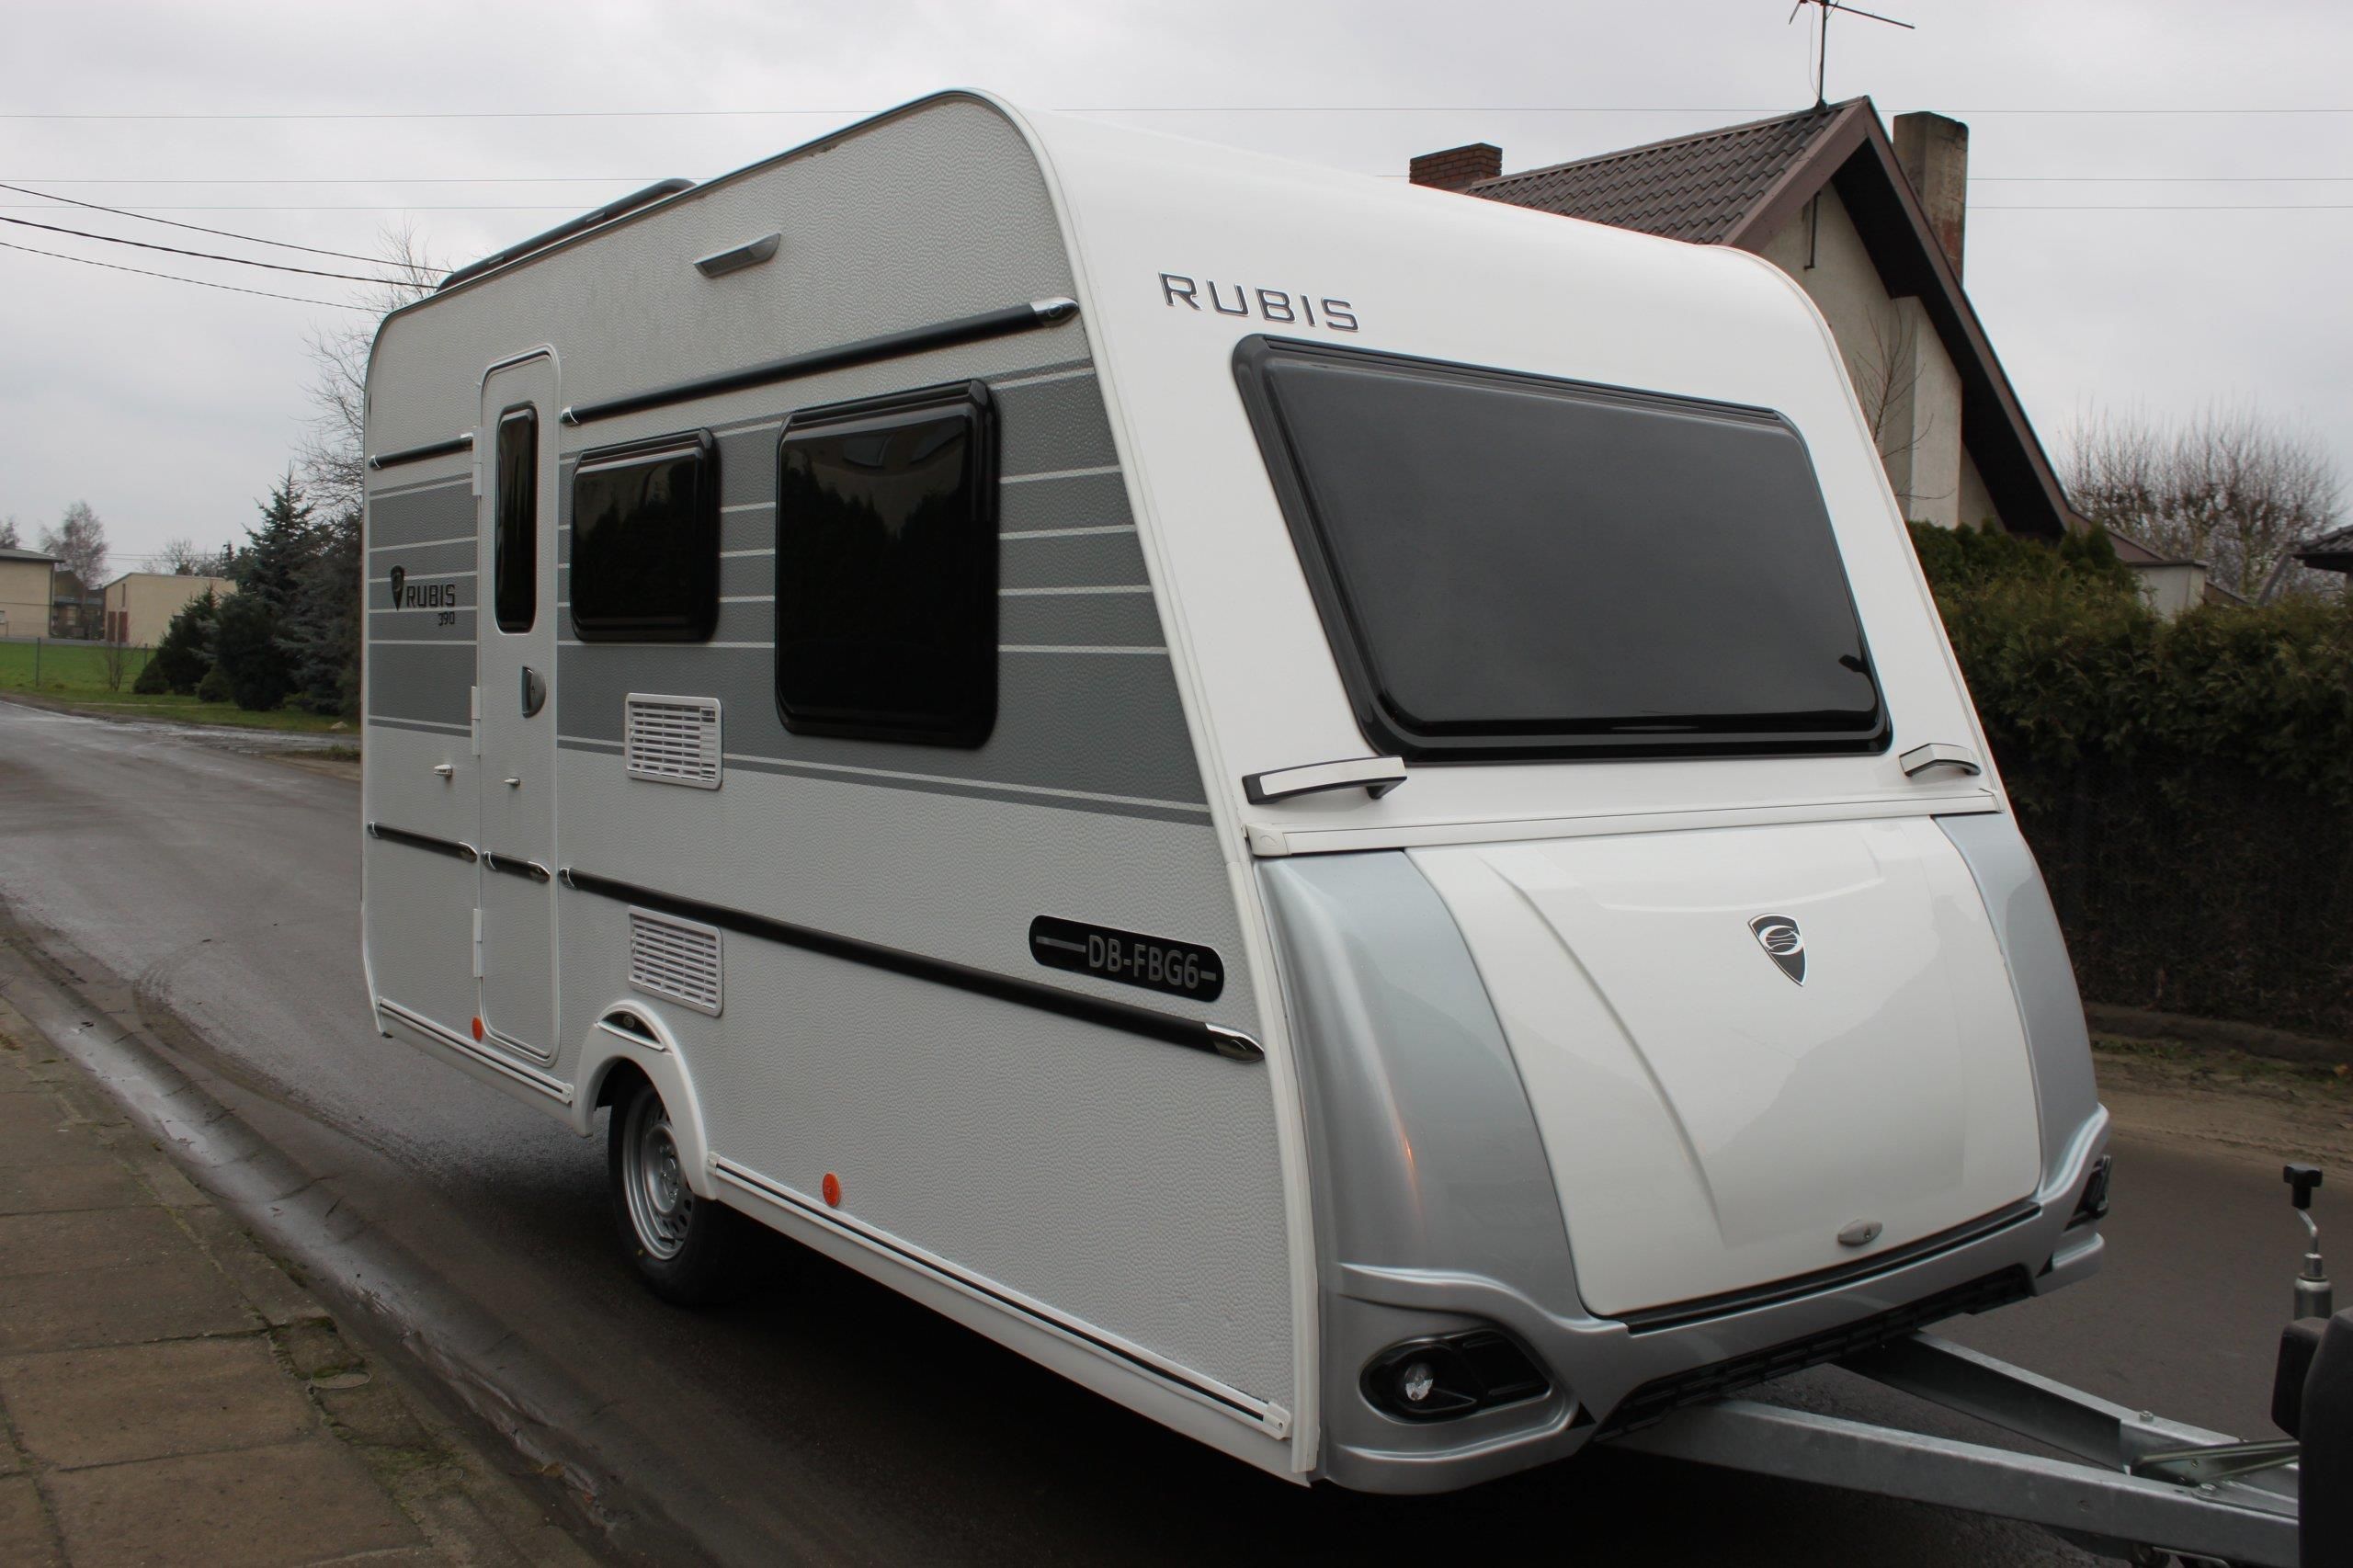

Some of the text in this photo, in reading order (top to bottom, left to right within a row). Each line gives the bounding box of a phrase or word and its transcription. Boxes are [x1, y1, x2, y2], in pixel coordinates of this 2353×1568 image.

[1158, 271, 1360, 332] RUBIS
[406, 584, 455, 608] RUBIS
[438, 611, 455, 626] 390
